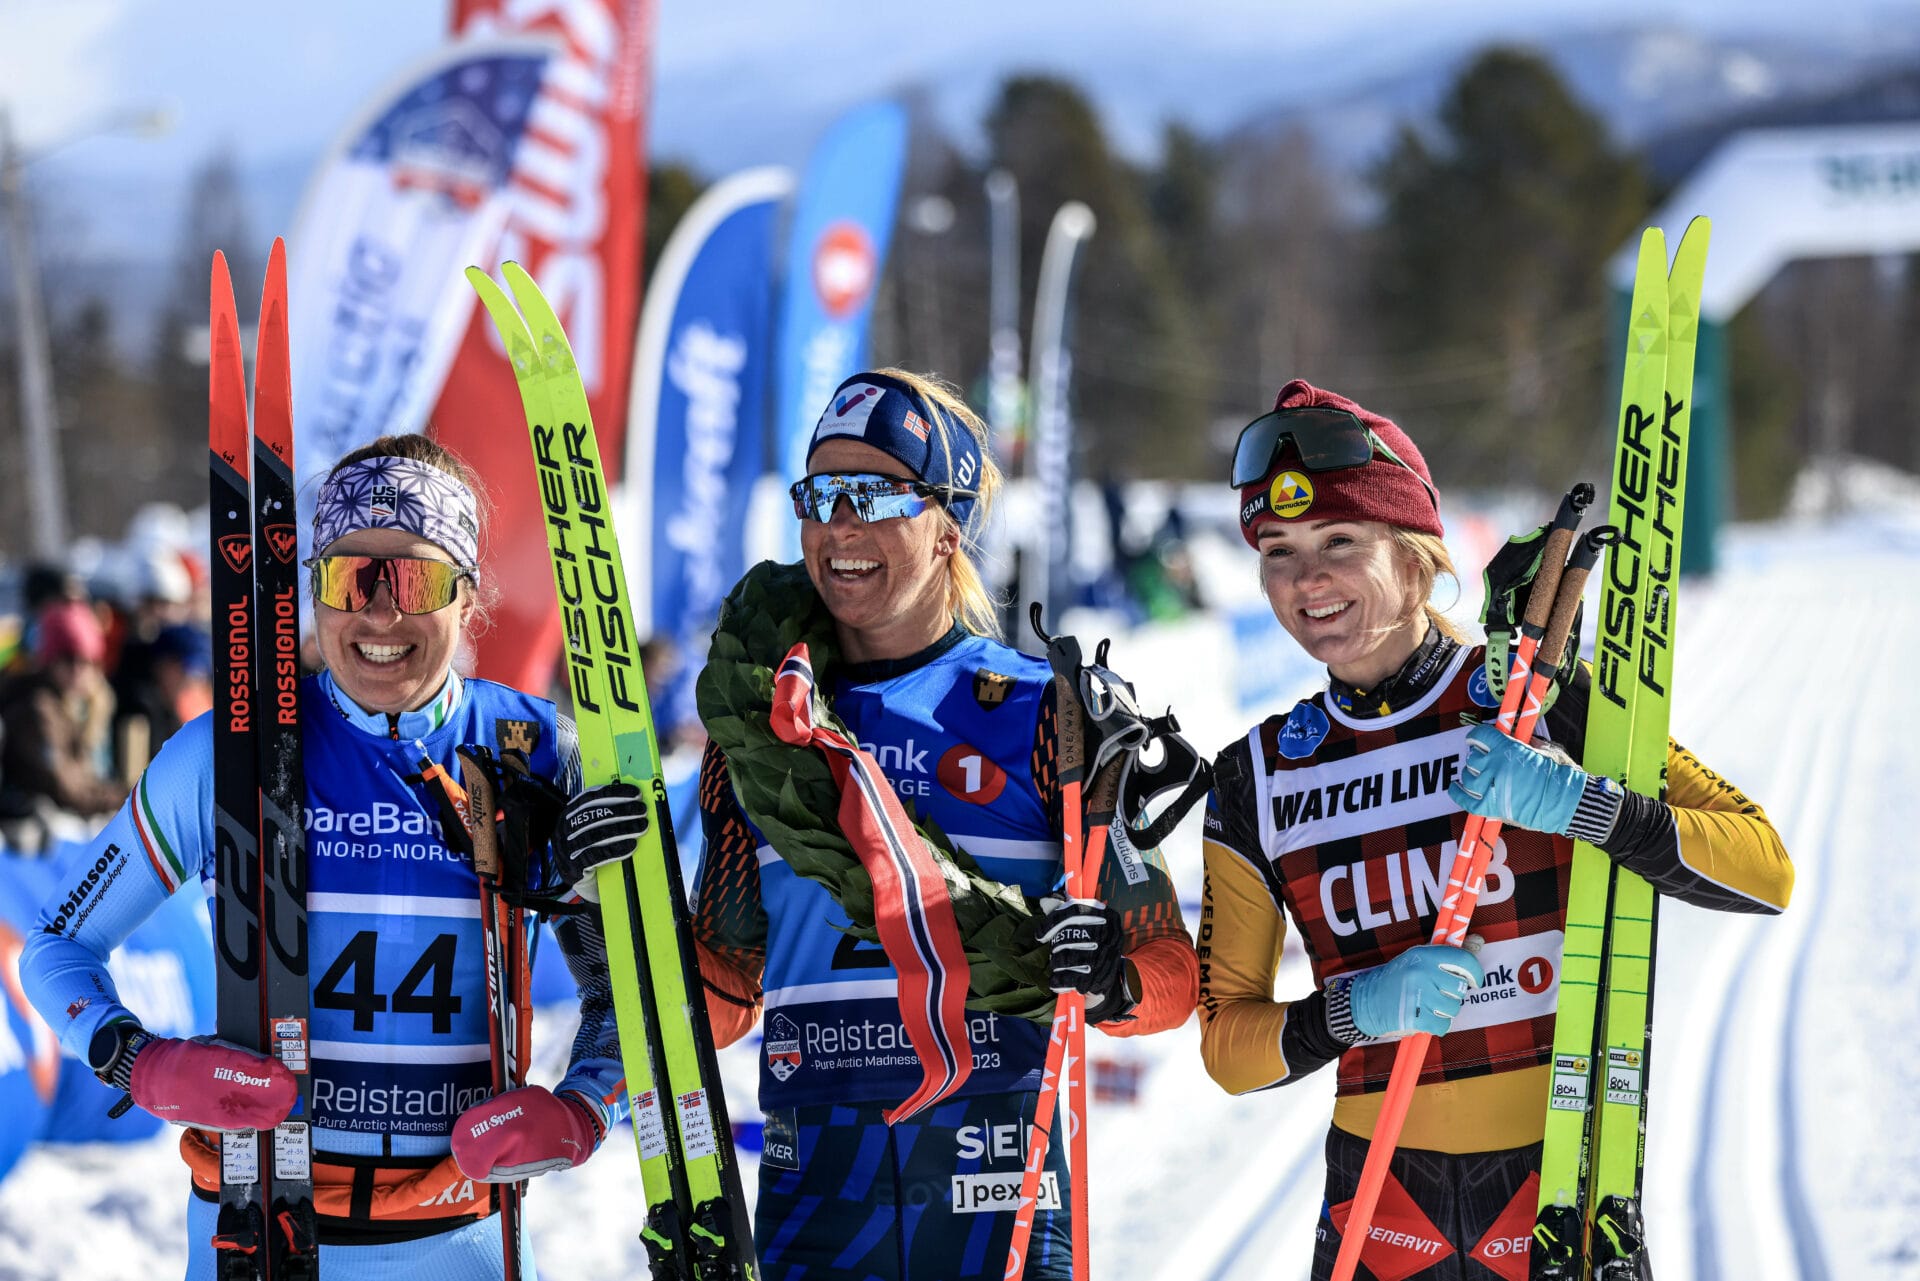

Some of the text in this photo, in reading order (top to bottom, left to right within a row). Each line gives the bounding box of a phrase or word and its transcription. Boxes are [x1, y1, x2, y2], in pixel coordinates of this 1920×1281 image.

[372, 486, 397, 496] US
[1241, 497, 1264, 522] TEAM
[1599, 404, 1655, 709] FISCHER
[1638, 390, 1684, 698] FISCHER
[533, 424, 600, 714] FISCHER
[563, 422, 640, 713] FISCHER
[229, 595, 250, 732] ROSSIGNOL
[275, 586, 297, 724] ROSSIGNOL
[1272, 753, 1460, 832] WATCH LIVE
[570, 807, 614, 828] HESTRA
[1051, 928, 1091, 945] HESTRA
[313, 930, 462, 1034] 44
[836, 1056, 863, 1069] Arctic
[865, 1054, 921, 1067] Madness!
[1556, 1084, 1577, 1095] 804
[1609, 1077, 1630, 1090] 804
[318, 1116, 448, 1132] Pure Arctic Madness!
[763, 1141, 793, 1161] AKER
[1372, 1227, 1442, 1256] ENERVIT
